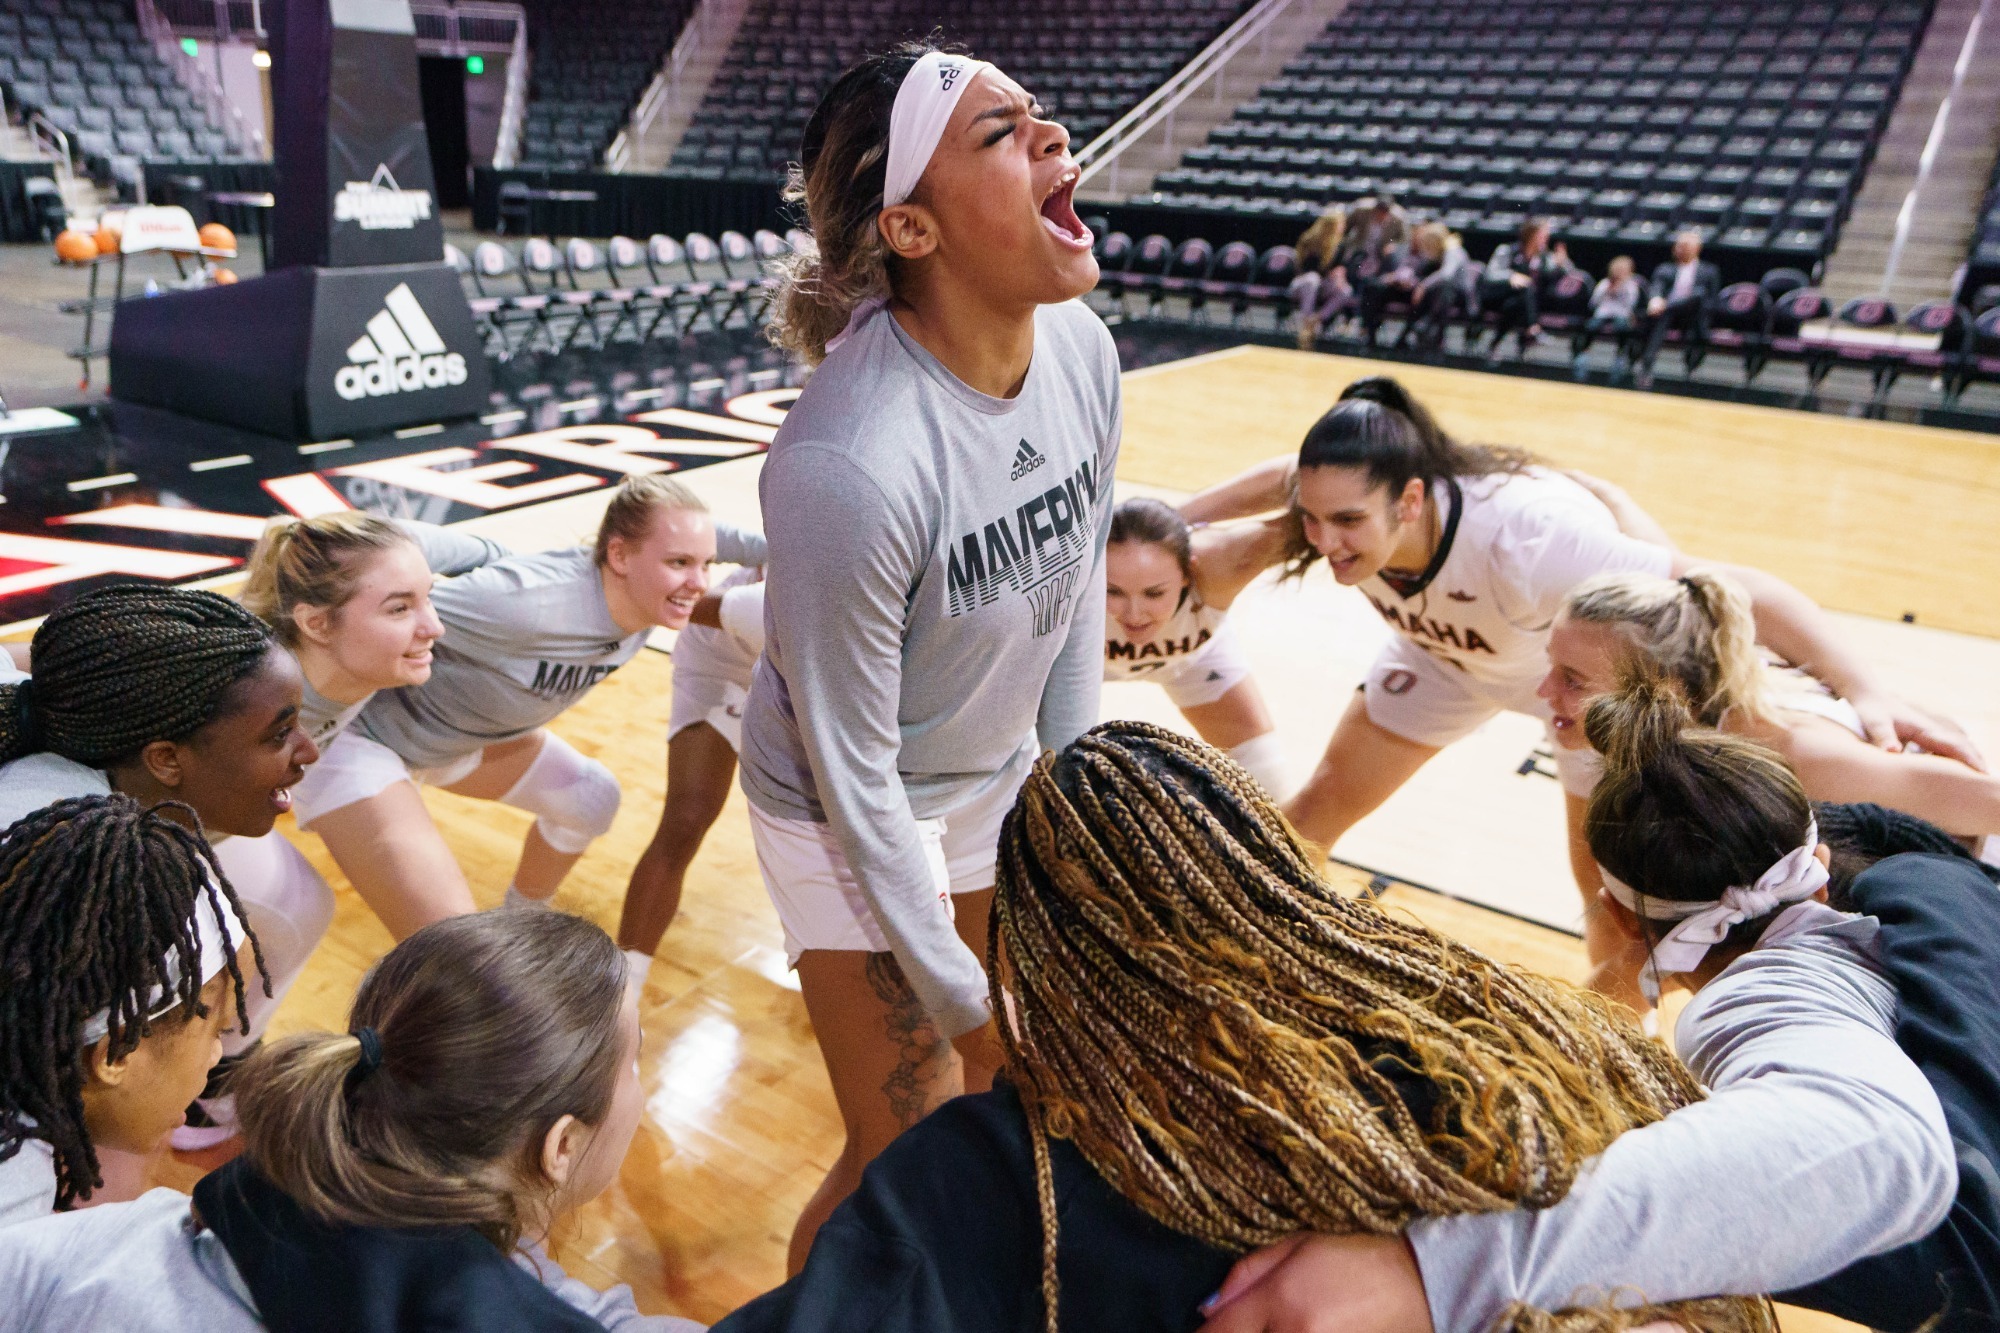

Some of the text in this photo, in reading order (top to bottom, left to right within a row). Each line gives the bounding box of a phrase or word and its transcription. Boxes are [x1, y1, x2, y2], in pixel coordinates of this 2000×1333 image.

[334, 351, 468, 400] adidas
[1010, 453, 1046, 482] adidas
[1104, 627, 1212, 661] MAHA
[530, 660, 620, 701] MAVE
